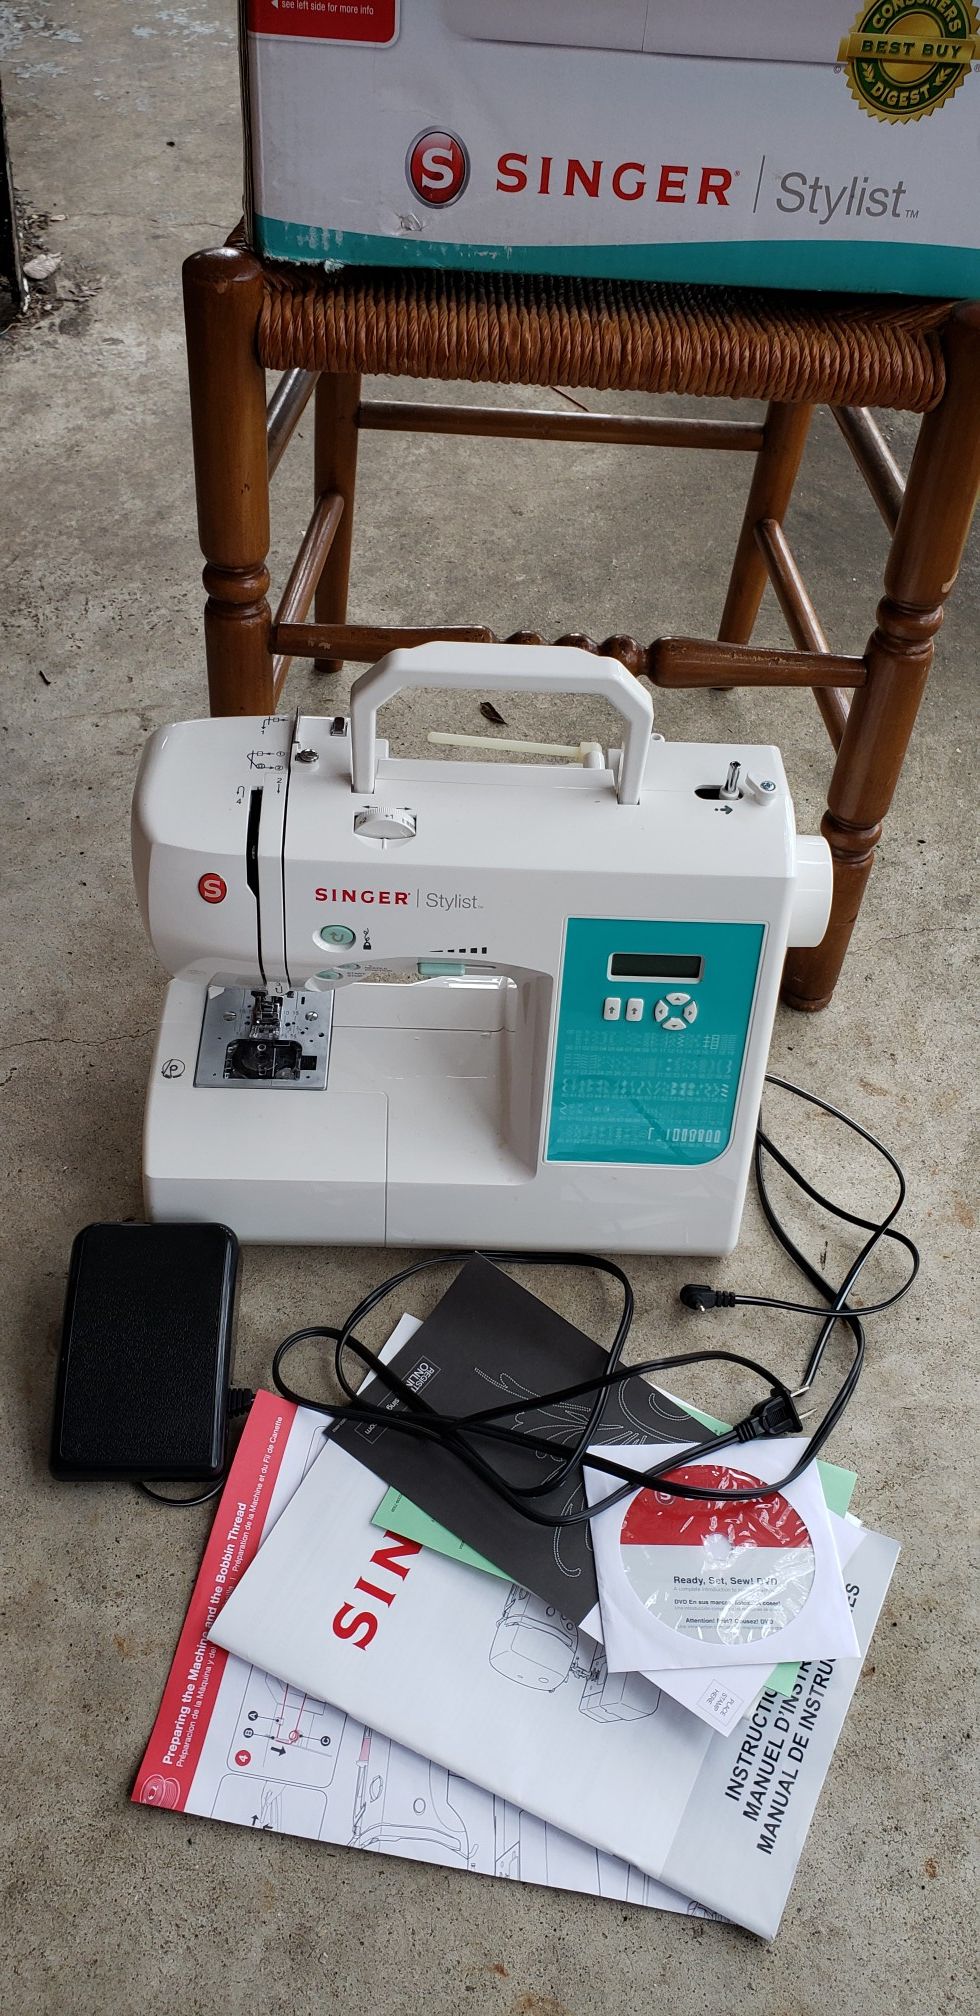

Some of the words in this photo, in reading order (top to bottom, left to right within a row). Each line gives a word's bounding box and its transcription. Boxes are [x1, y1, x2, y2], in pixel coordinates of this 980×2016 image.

[281, 0, 295, 9] see
[296, 0, 309, 10] left
[310, 2, 326, 11] side
[327, 3, 338, 12] for
[339, 5, 359, 13] more
[360, 5, 374, 15] info
[861, 39, 916, 56] BEST
[921, 43, 962, 59] BUY
[871, 81, 931, 107] DIGEST
[496, 152, 732, 206] SINGER
[776, 171, 907, 225] Stylist
[314, 887, 409, 905] SINGER
[425, 892, 479, 911] Stylist
[227, 1502, 247, 1541] Thread
[191, 1709, 199, 1720] de
[232, 1530, 249, 1572] Préparation
[245, 1519, 253, 1531] de
[249, 1481, 263, 1513] Machine
[261, 1462, 269, 1475] du
[269, 1416, 283, 1444] Canette
[216, 1543, 236, 1584] Bobbin
[673, 1575, 706, 1587] Ready,
[730, 1577, 754, 1586] Sew!
[210, 1586, 224, 1606] the
[332, 1529, 423, 1651] SIN
[205, 1606, 217, 1630] and
[188, 1632, 208, 1681] Machine
[181, 1683, 196, 1704] the
[162, 1706, 191, 1765] Preparing
[742, 1738, 785, 1822] MANUEL
[756, 1768, 799, 1856] MANUAL
[787, 1731, 810, 1764] DE
